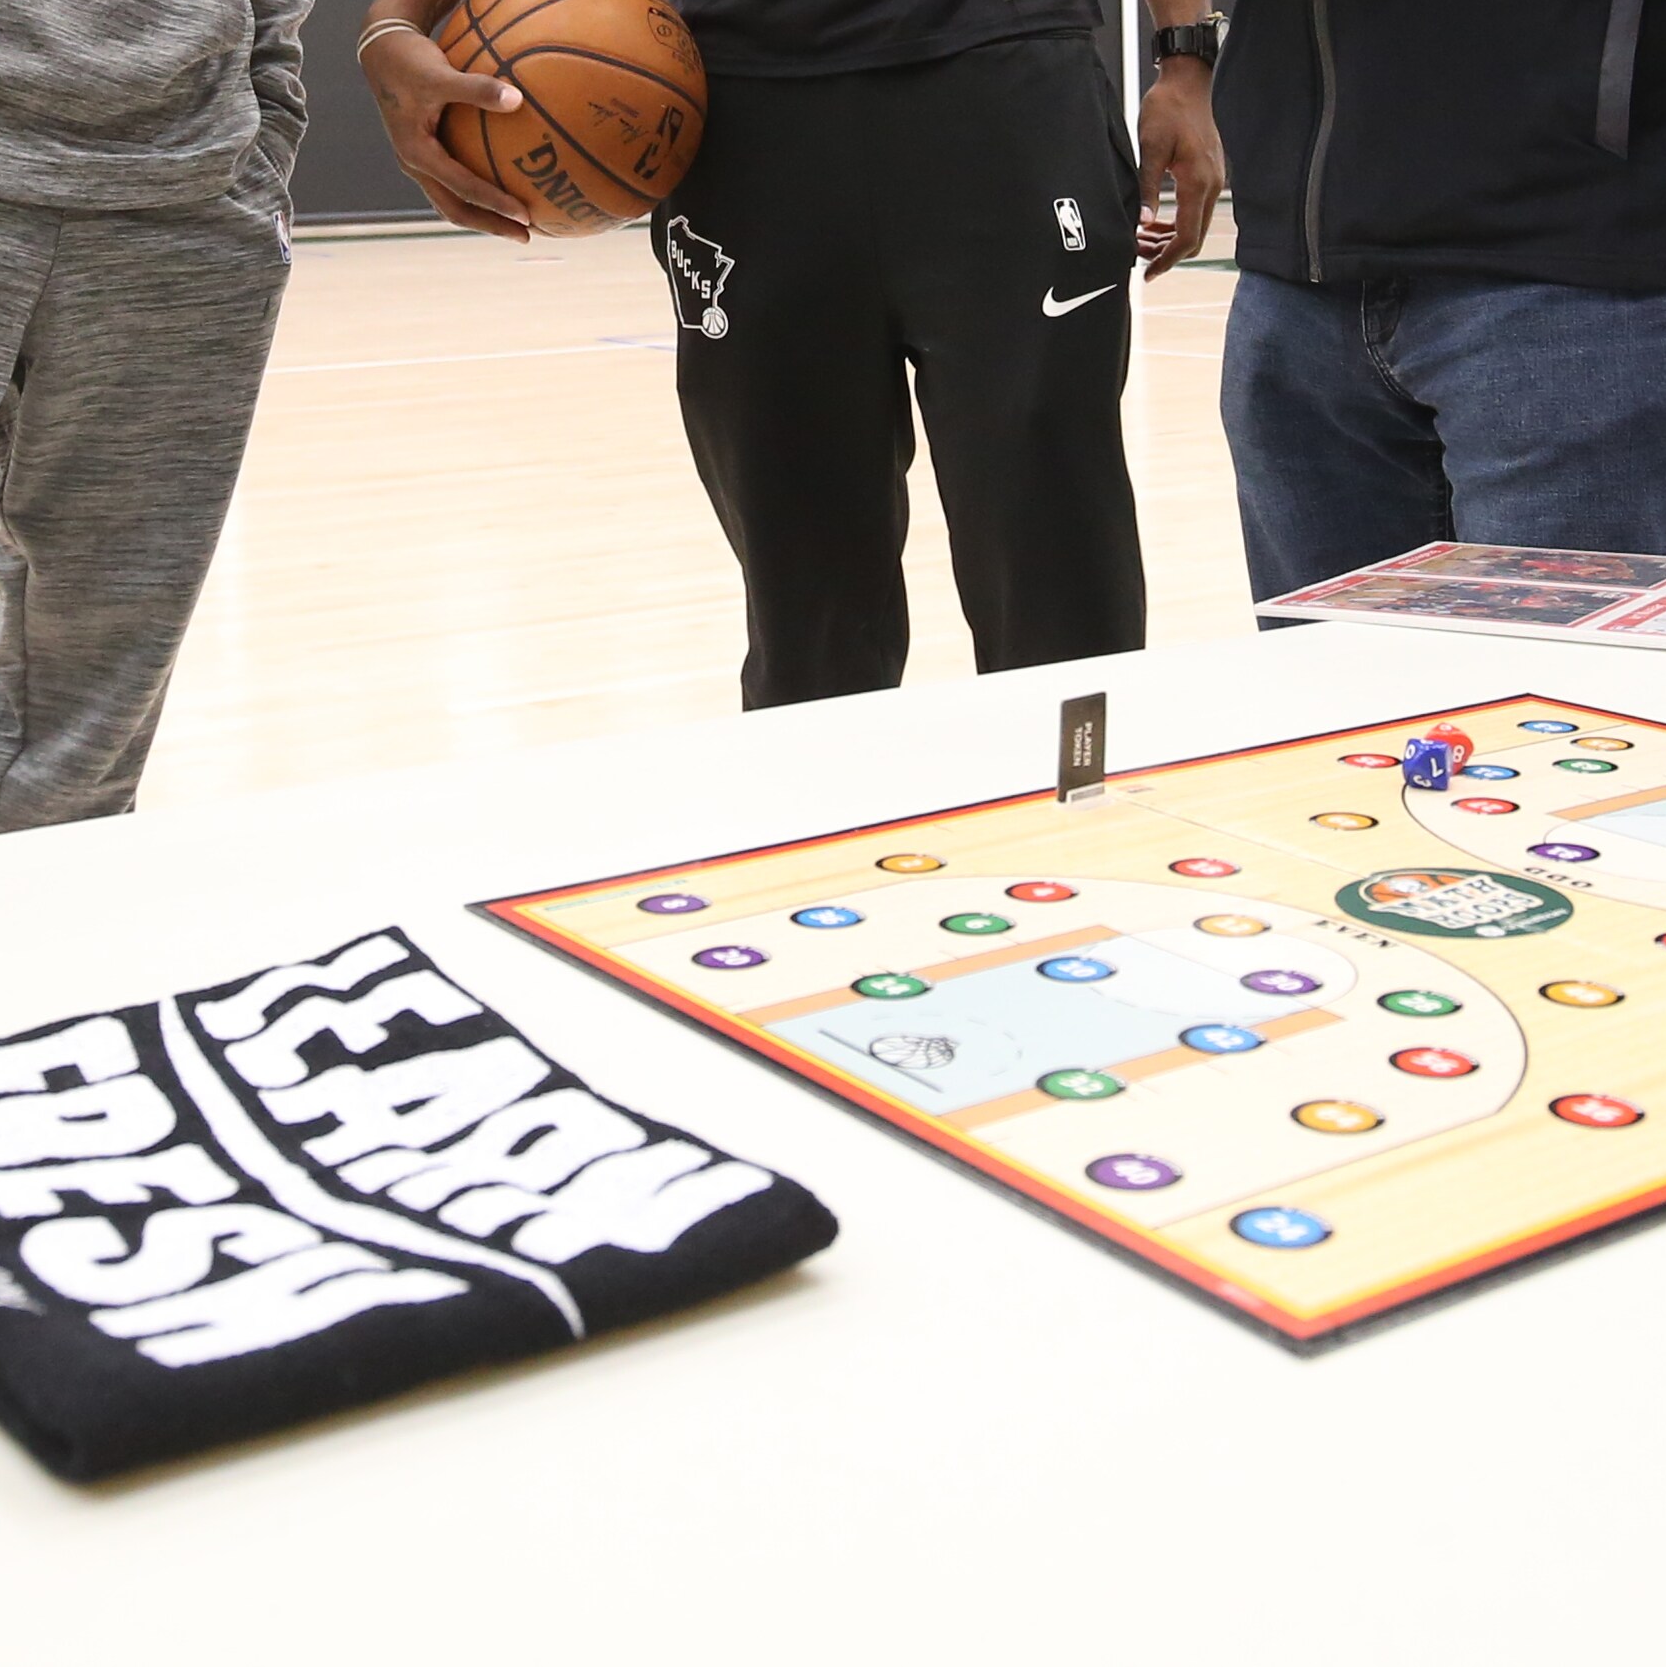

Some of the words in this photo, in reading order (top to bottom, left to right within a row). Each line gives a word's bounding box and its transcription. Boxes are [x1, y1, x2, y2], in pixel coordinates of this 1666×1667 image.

[670, 240, 711, 299] BUCKS
[1397, 877, 1501, 915] MATH
[1431, 891, 1536, 927] HOOPS
[1311, 919, 1401, 949] EVEN
[712, 948, 751, 966] 20
[1057, 960, 1097, 978] 10
[193, 930, 776, 1264] LEARN
[1113, 1160, 1160, 1185] 40
